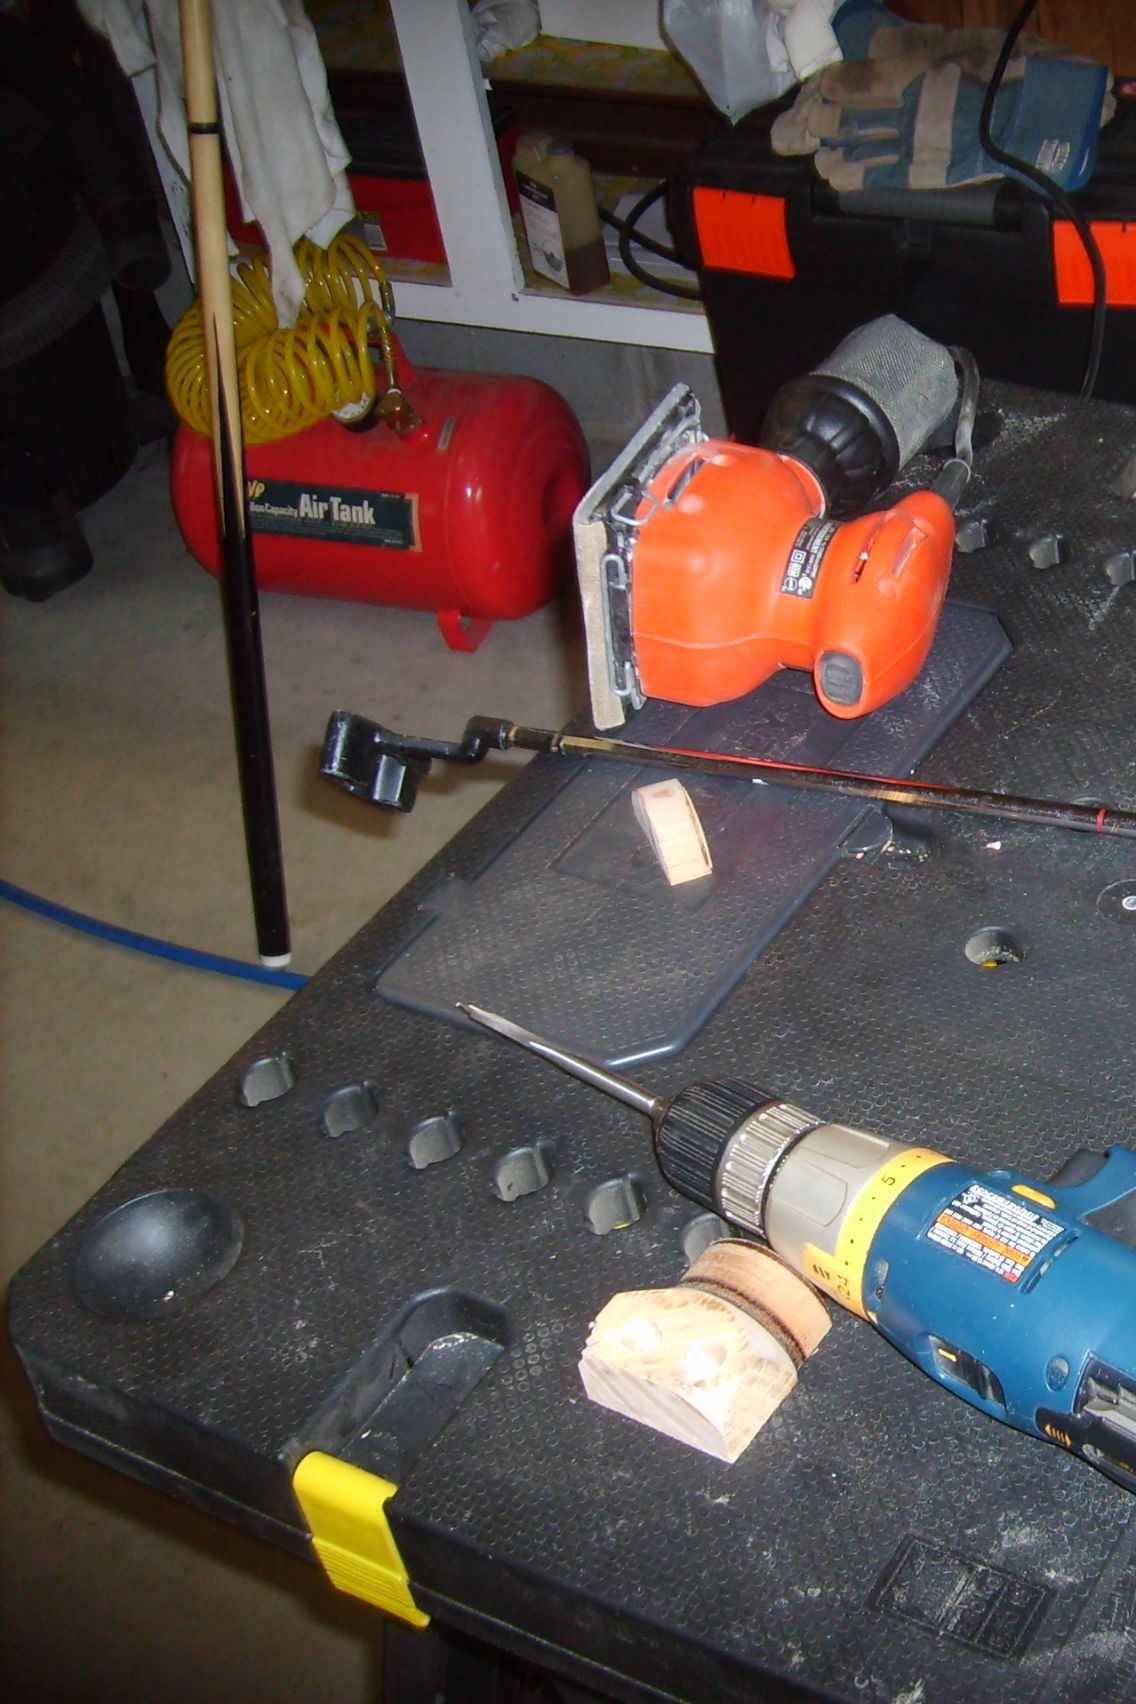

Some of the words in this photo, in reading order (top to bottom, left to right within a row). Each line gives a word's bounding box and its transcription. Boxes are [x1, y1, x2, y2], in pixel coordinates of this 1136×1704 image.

[300, 493, 329, 519] Air
[330, 496, 376, 525] Tank
[881, 1176, 896, 1186] 5
